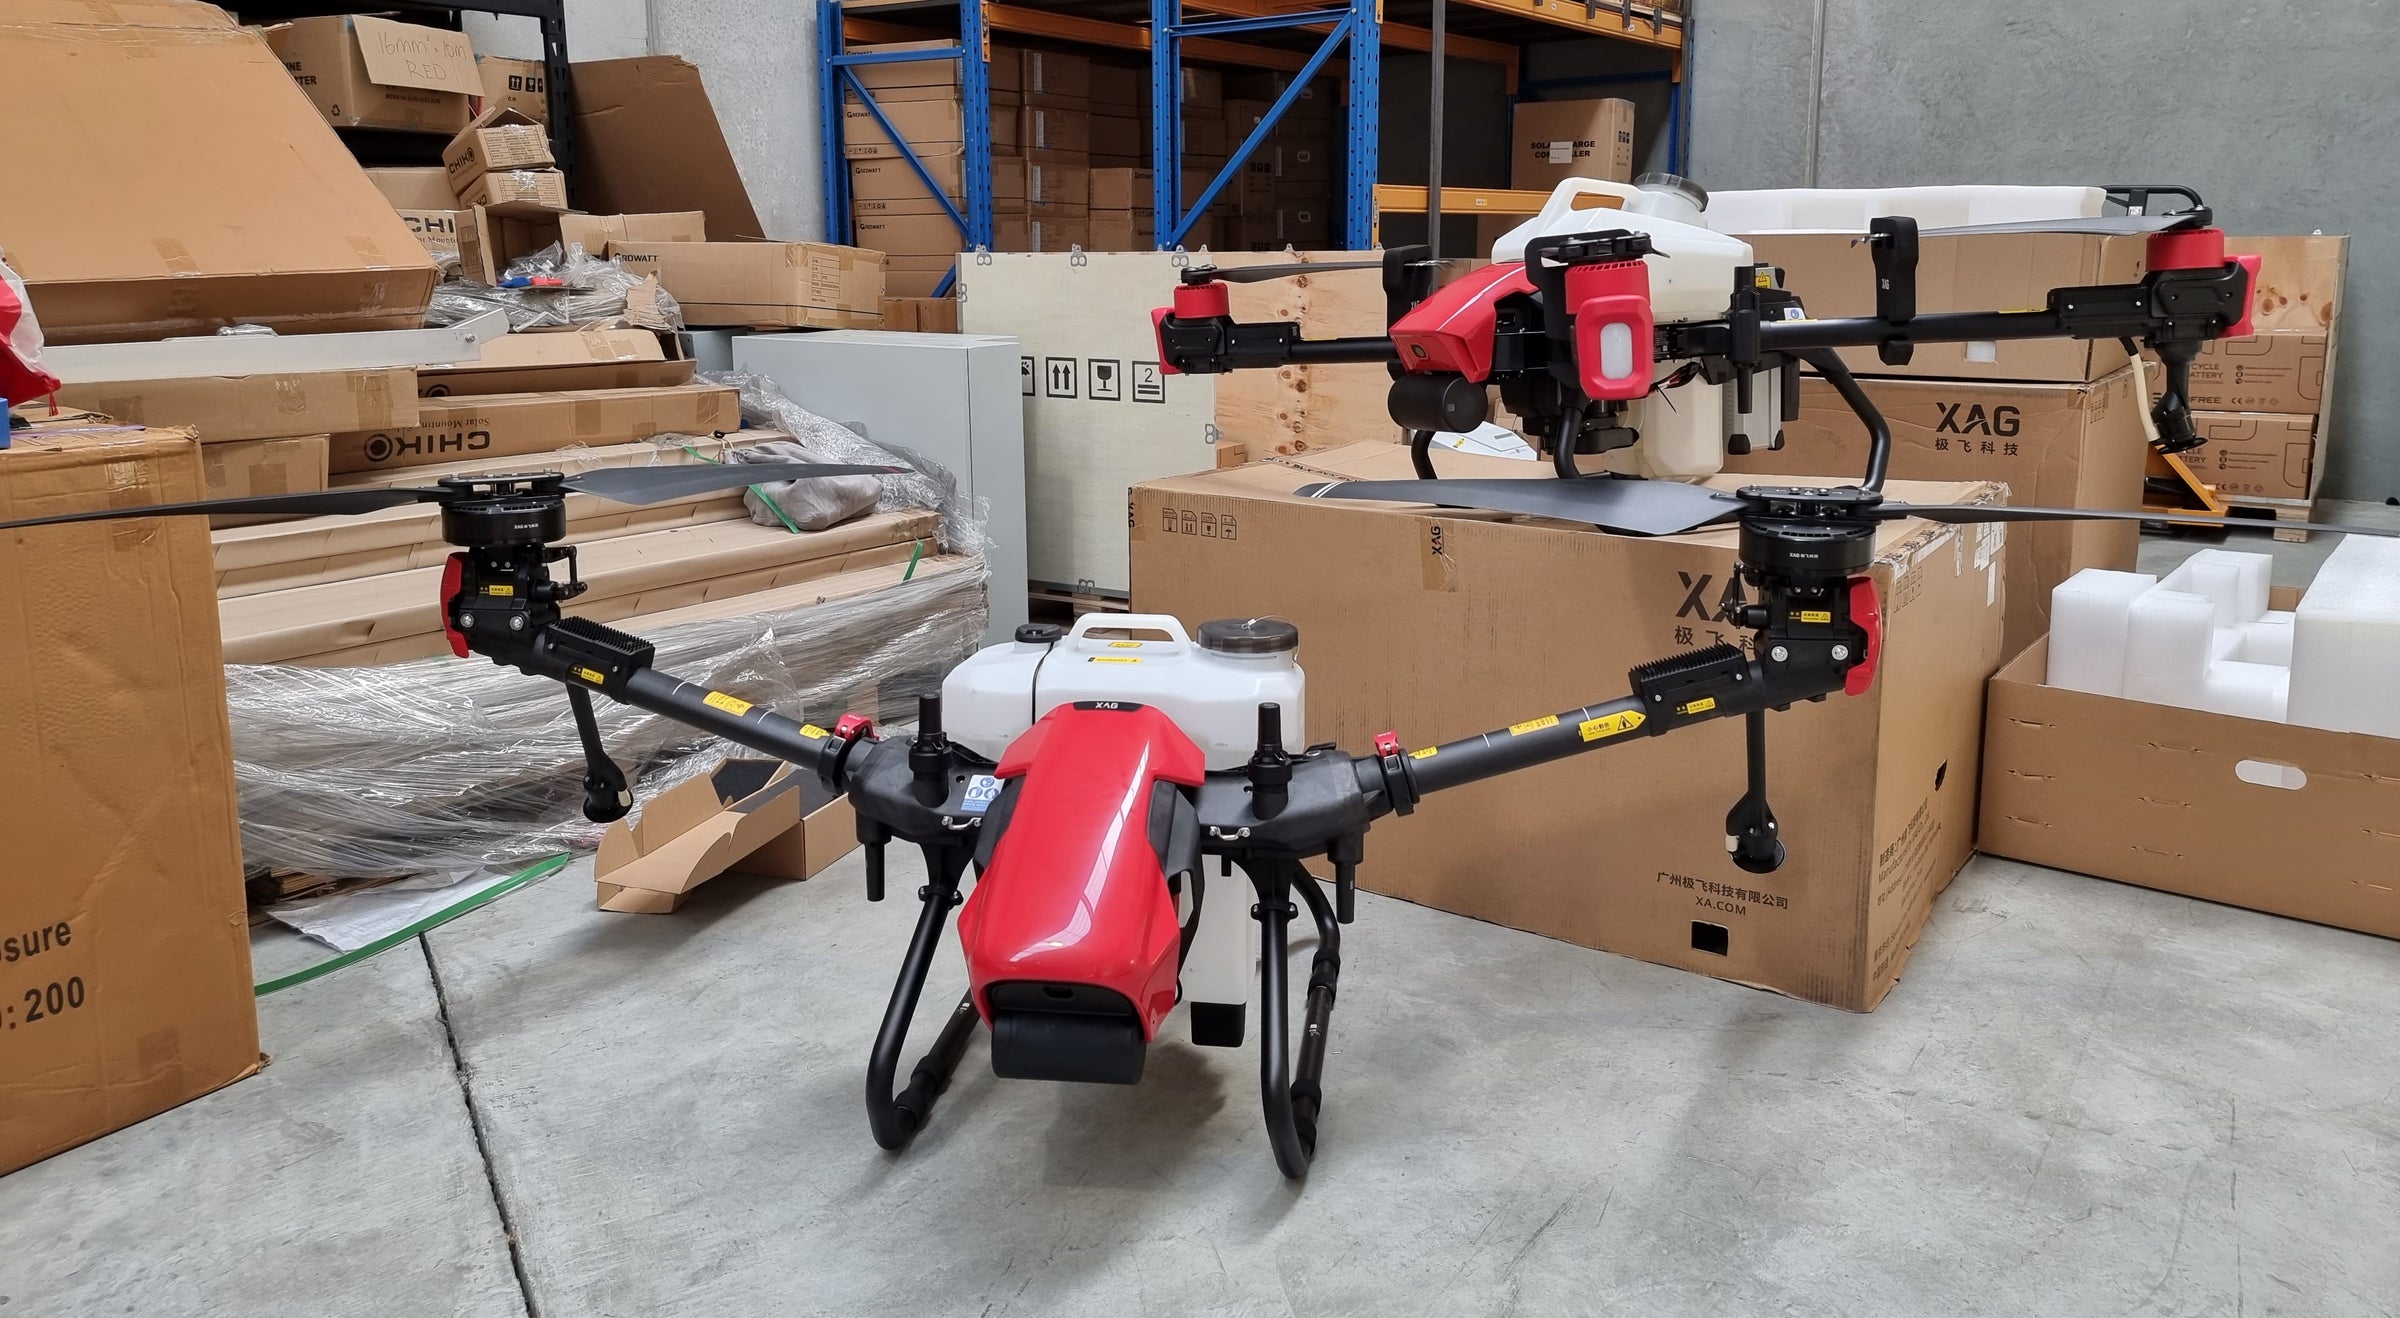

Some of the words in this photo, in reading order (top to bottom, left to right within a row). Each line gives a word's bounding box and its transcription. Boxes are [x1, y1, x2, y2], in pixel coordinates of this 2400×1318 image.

[406, 60, 447, 80] RED
[1530, 141, 1551, 149] SOLA
[404, 217, 454, 232] CHI
[2190, 371, 2223, 379] ATTERY
[420, 419, 463, 429] Mountin
[466, 417, 490, 427] Solar
[1936, 402, 2020, 437] XAG
[1935, 438, 2019, 456] 极飞科技
[1431, 526, 1442, 555] XAG
[1676, 571, 1747, 622] XA
[1674, 625, 1754, 650] 极飞科
[1657, 871, 1788, 910] 广州极飞科技有限公司
[1695, 896, 1746, 915] XA.COM
[3, 921, 72, 962] sure
